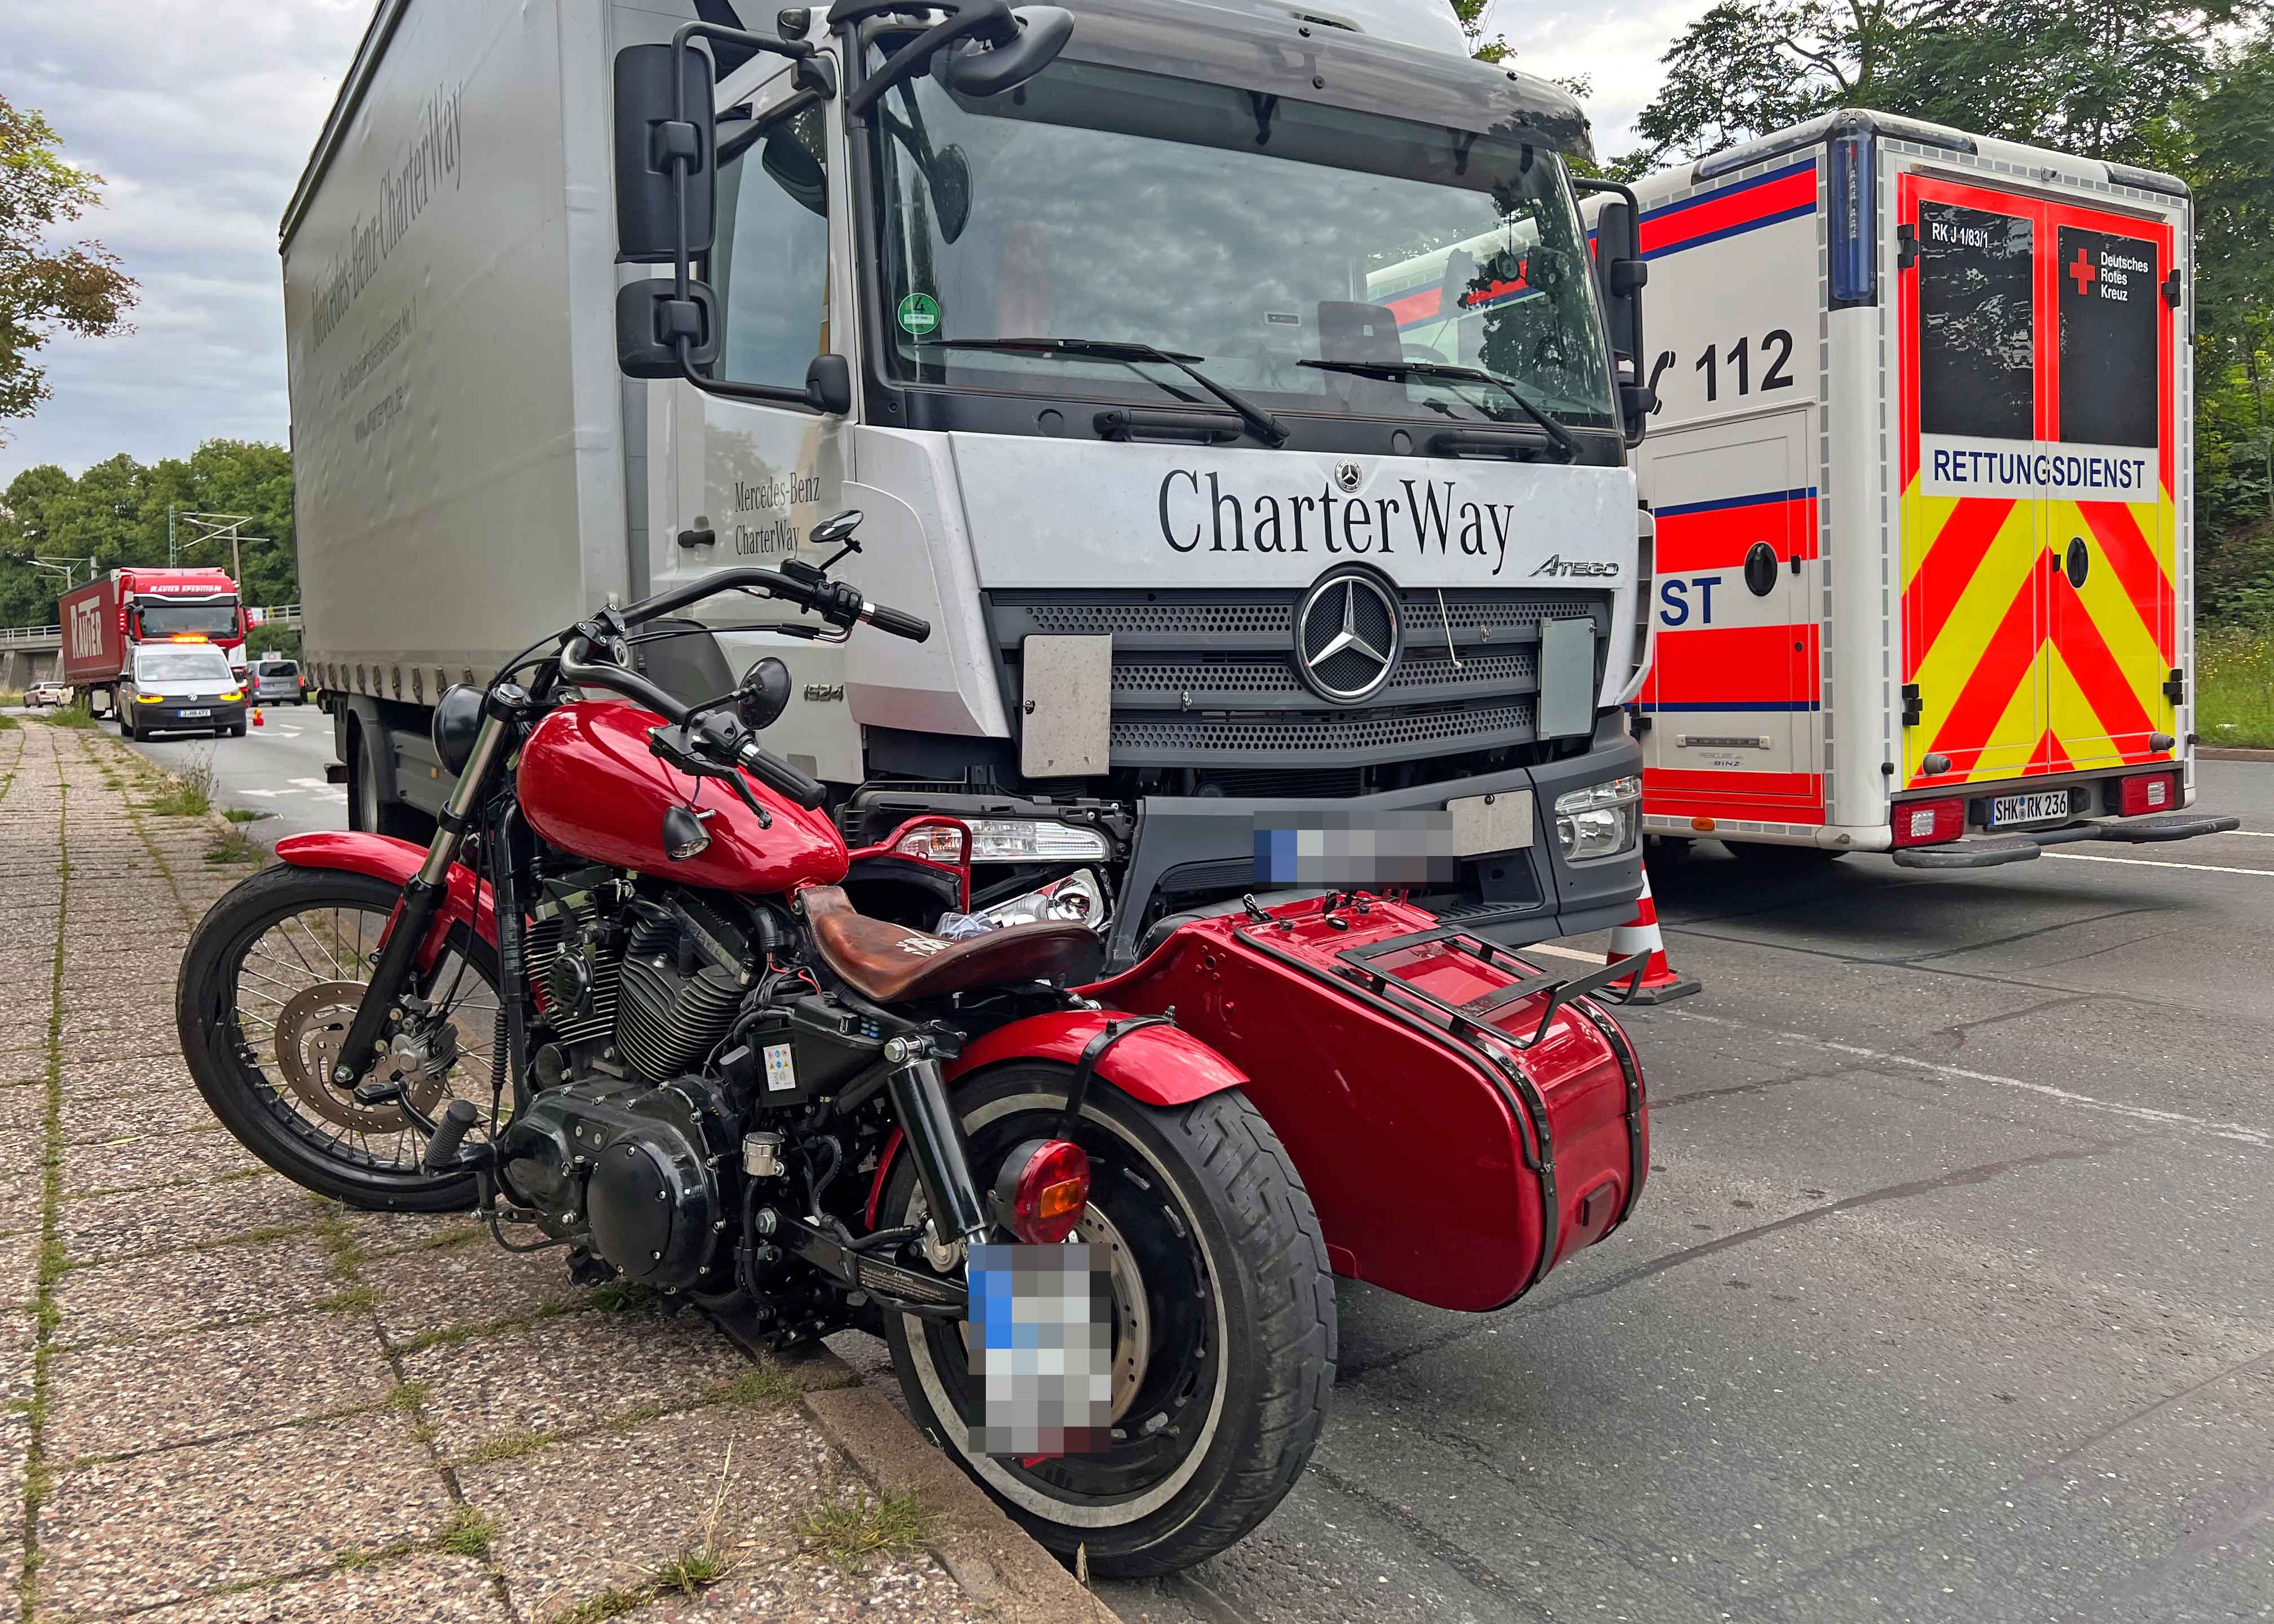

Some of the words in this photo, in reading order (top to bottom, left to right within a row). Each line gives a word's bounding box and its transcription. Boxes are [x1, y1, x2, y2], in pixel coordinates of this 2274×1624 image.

[379, 81, 462, 261] CharterWay
[1932, 223, 1948, 242] RK
[1950, 226, 1958, 243] J
[1960, 227, 1989, 249] 1/83/1
[2101, 251, 2149, 273] Deutsches
[2101, 268, 2128, 285] Rotes
[914, 297, 926, 314] 4
[2101, 285, 2128, 302] Kreuz
[1695, 329, 1794, 402] 112
[1933, 449, 2145, 489] RETTUNGSDIENST
[735, 472, 821, 513] Mercedes-Benz
[735, 518, 800, 559] CharterWay
[1159, 468, 1514, 575] CharterWay
[1659, 576, 1722, 628] ST
[1995, 798, 2019, 821] SHK
[2027, 796, 2043, 818] RK
[2044, 794, 2066, 816] 236
